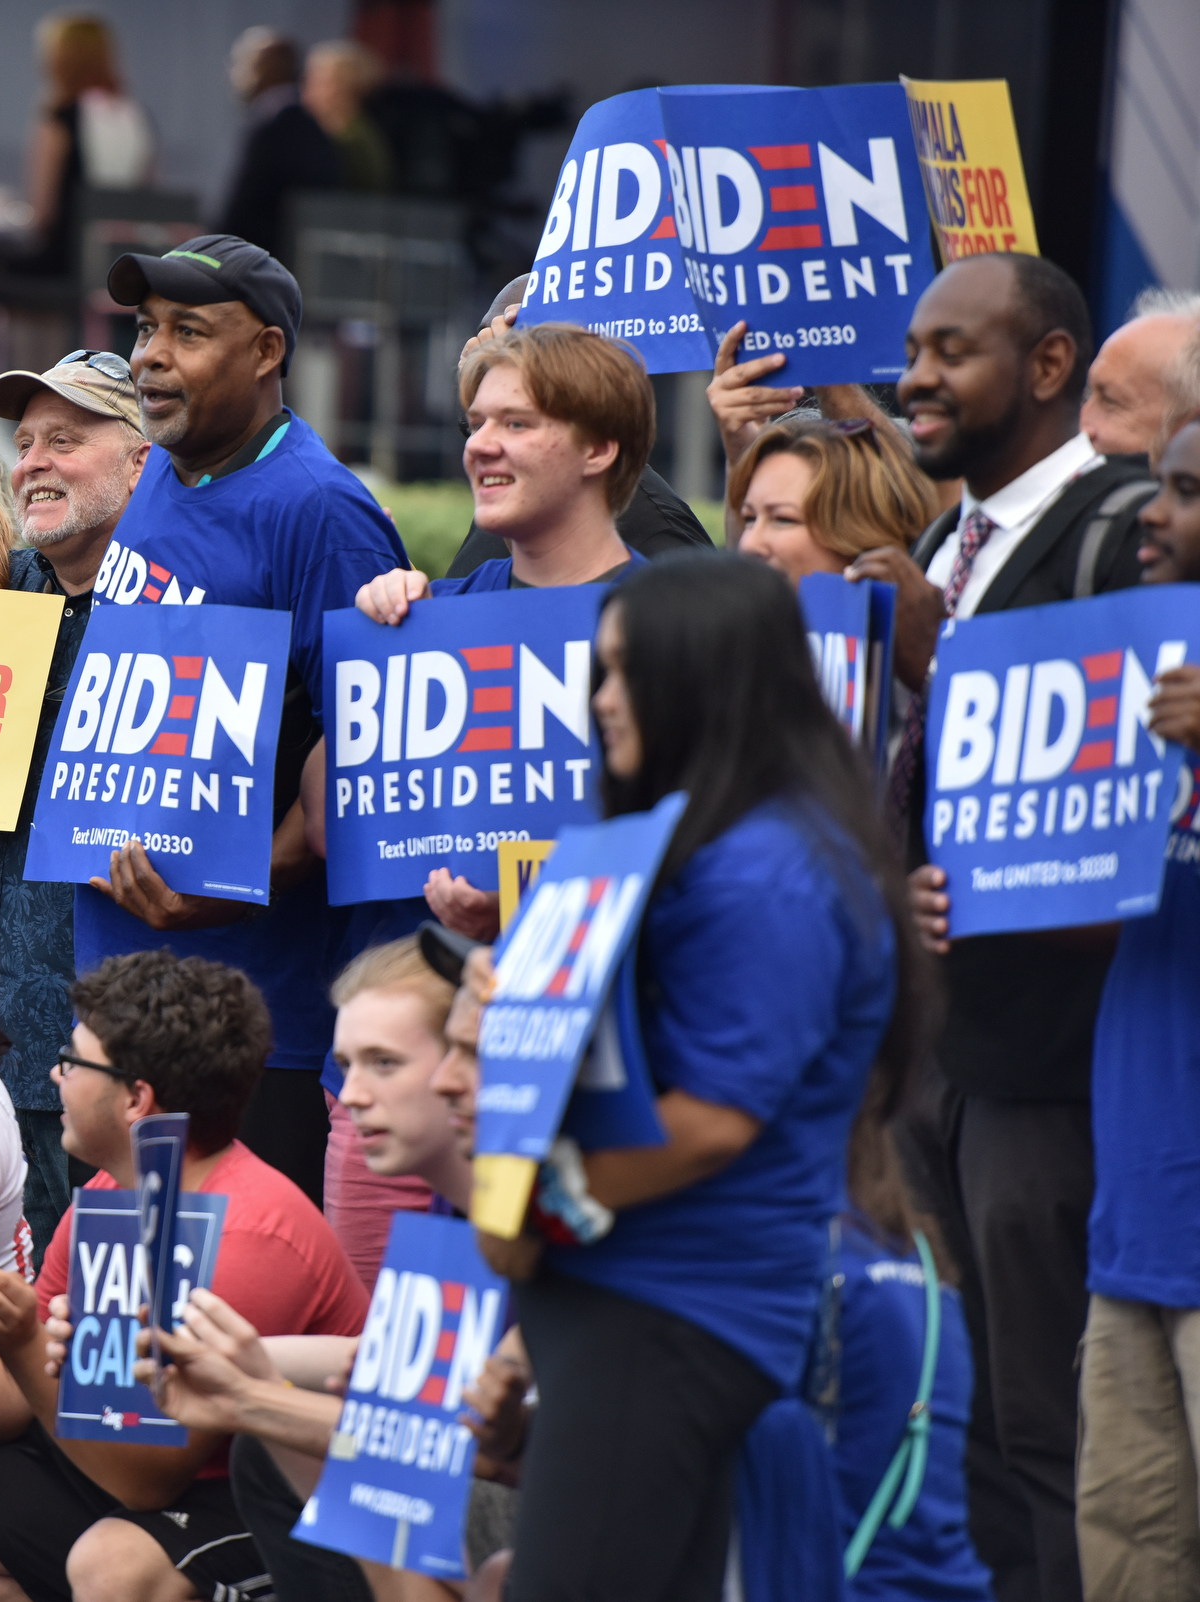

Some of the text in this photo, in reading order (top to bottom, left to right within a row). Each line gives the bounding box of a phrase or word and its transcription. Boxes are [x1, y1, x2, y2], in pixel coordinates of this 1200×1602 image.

[534, 138, 677, 262] BID
[666, 137, 909, 255] BIDEN
[961, 166, 1013, 229] FOR
[521, 251, 673, 308] PRESID
[685, 253, 912, 306] PRESIDENT
[649, 317, 666, 335] to
[668, 314, 704, 334] 303
[773, 330, 795, 349] to
[797, 324, 857, 348] 30330
[60, 652, 268, 767] BIDEN
[335, 640, 591, 768] BIDEN
[935, 640, 1187, 791] BIDEN
[50, 761, 254, 817] PRESIDENT
[337, 758, 591, 818] PRESIDENT
[933, 770, 1163, 847] PRESIDENT
[71, 827, 90, 845] Text
[90, 828, 130, 848] UNITED
[143, 832, 193, 855] 30330
[377, 840, 406, 859] Text
[407, 834, 453, 857] UNITED
[455, 835, 474, 852] to
[349, 1267, 501, 1412] BIDEN
[340, 1399, 473, 1477] PRESIDENT
